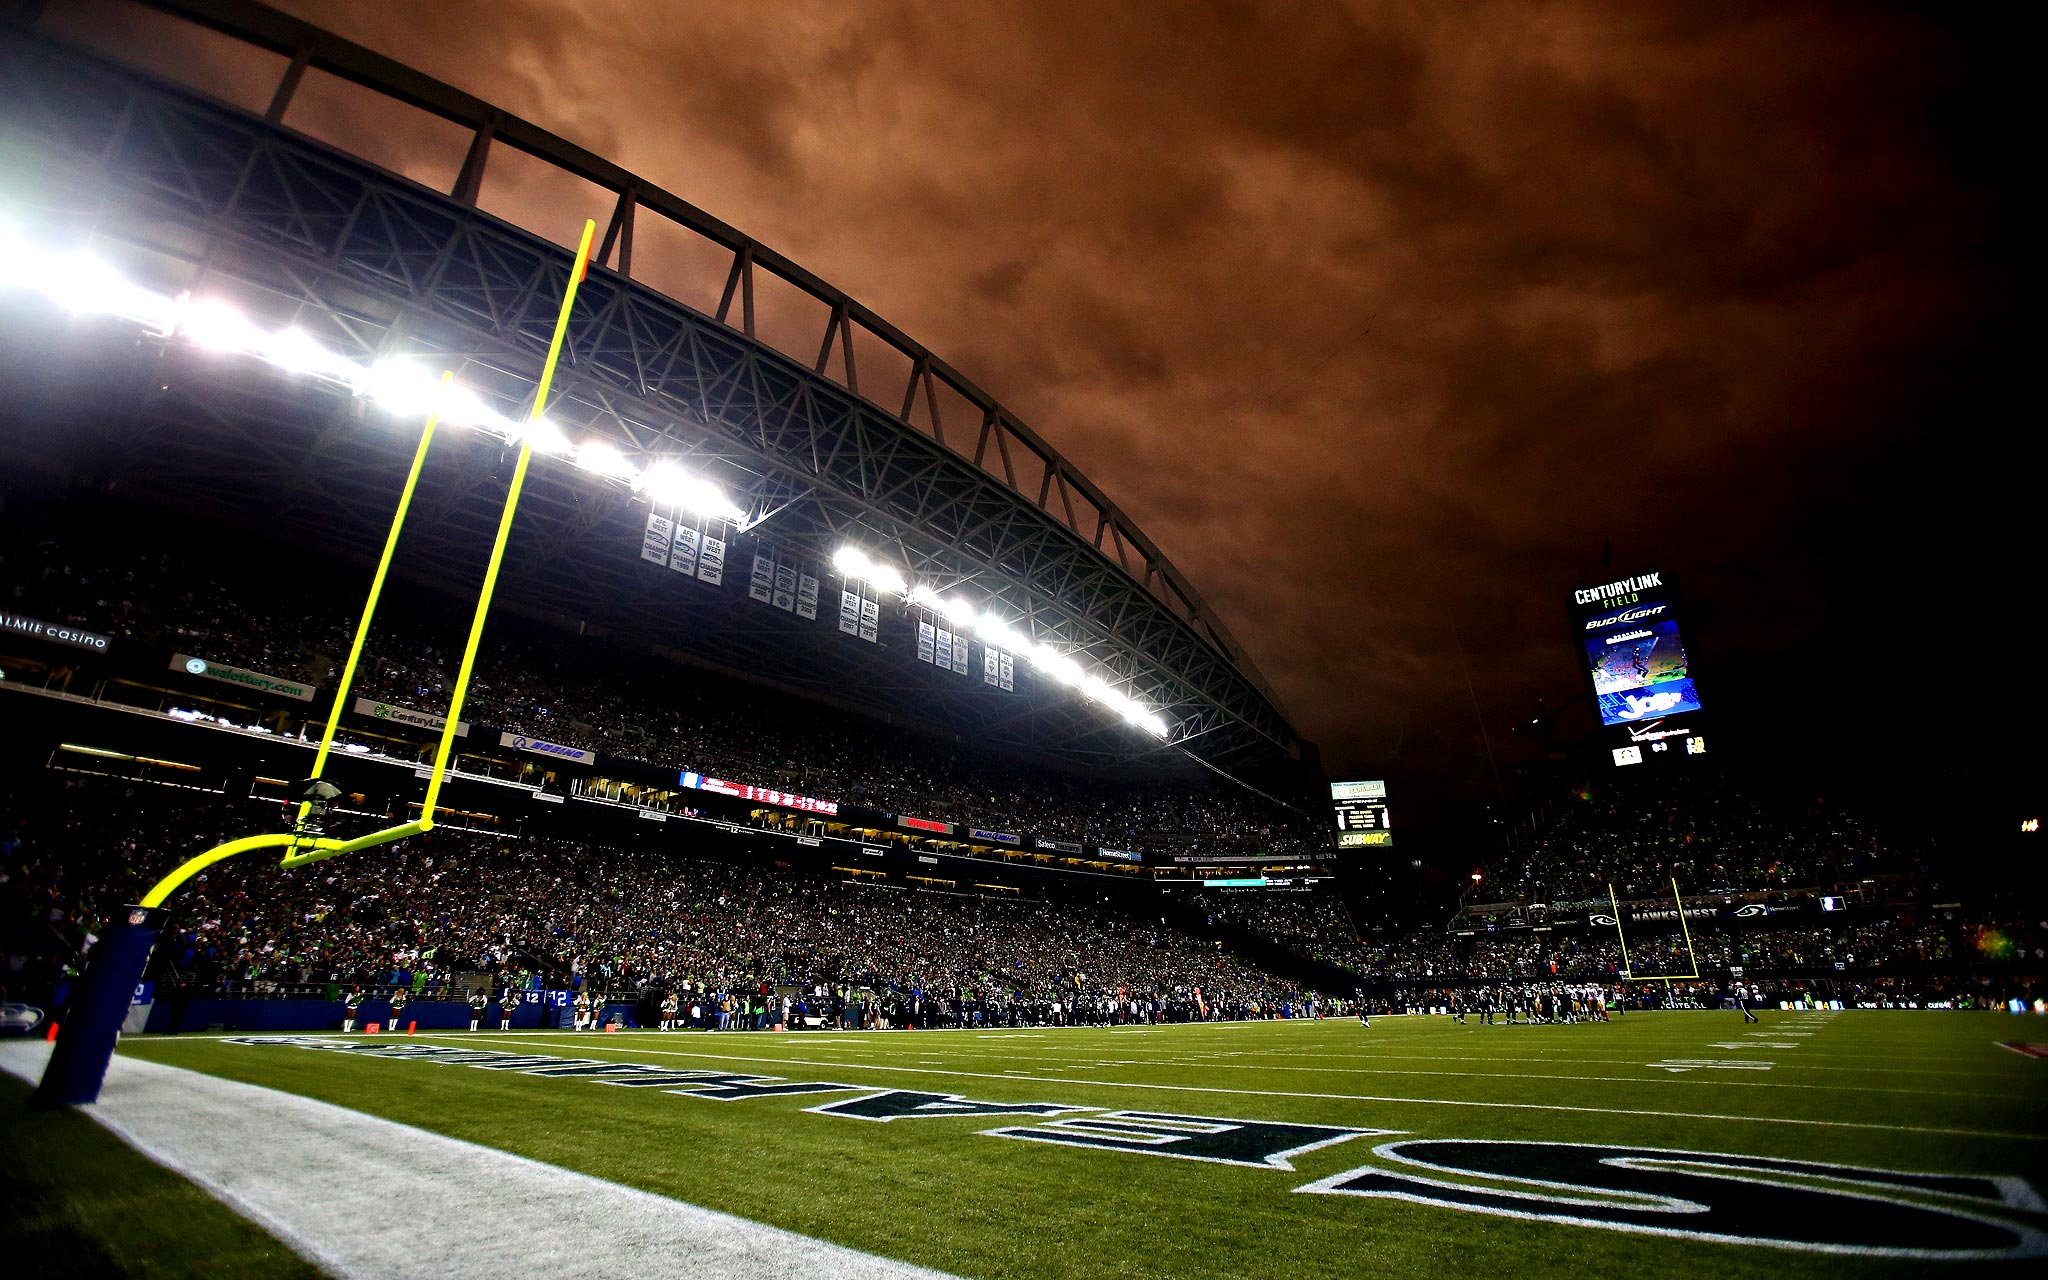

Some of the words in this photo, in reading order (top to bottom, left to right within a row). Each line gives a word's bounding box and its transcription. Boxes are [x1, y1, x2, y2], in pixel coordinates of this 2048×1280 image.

[652, 523, 667, 533] WEST
[655, 518, 667, 527] AFC
[680, 534, 695, 544] WEST
[682, 529, 694, 538] AFC
[645, 542, 667, 556] CHAMPS
[706, 544, 721, 555] WEST
[673, 553, 694, 566] CHAMPS
[700, 562, 722, 575] CHAMPS
[703, 569, 717, 579] 2004
[1574, 571, 1662, 605] CENTURYLINK
[1603, 592, 1639, 609] FIELD
[1585, 616, 1617, 630] BUD
[1622, 605, 1667, 621] LIGHT
[46, 627, 106, 648] casino
[207, 666, 303, 697] walottery.com
[390, 709, 450, 730] CenturyLin
[530, 741, 585, 759] BOEING
[974, 830, 992, 839] BUD
[993, 832, 1017, 842] LIGHT
[1340, 832, 1390, 846] SUBWAY
[1037, 839, 1056, 849] Safeco
[1631, 910, 1680, 922] HAWKS
[1683, 908, 1718, 919] NEST
[525, 992, 539, 1004] 12
[550, 990, 567, 1007] 12
